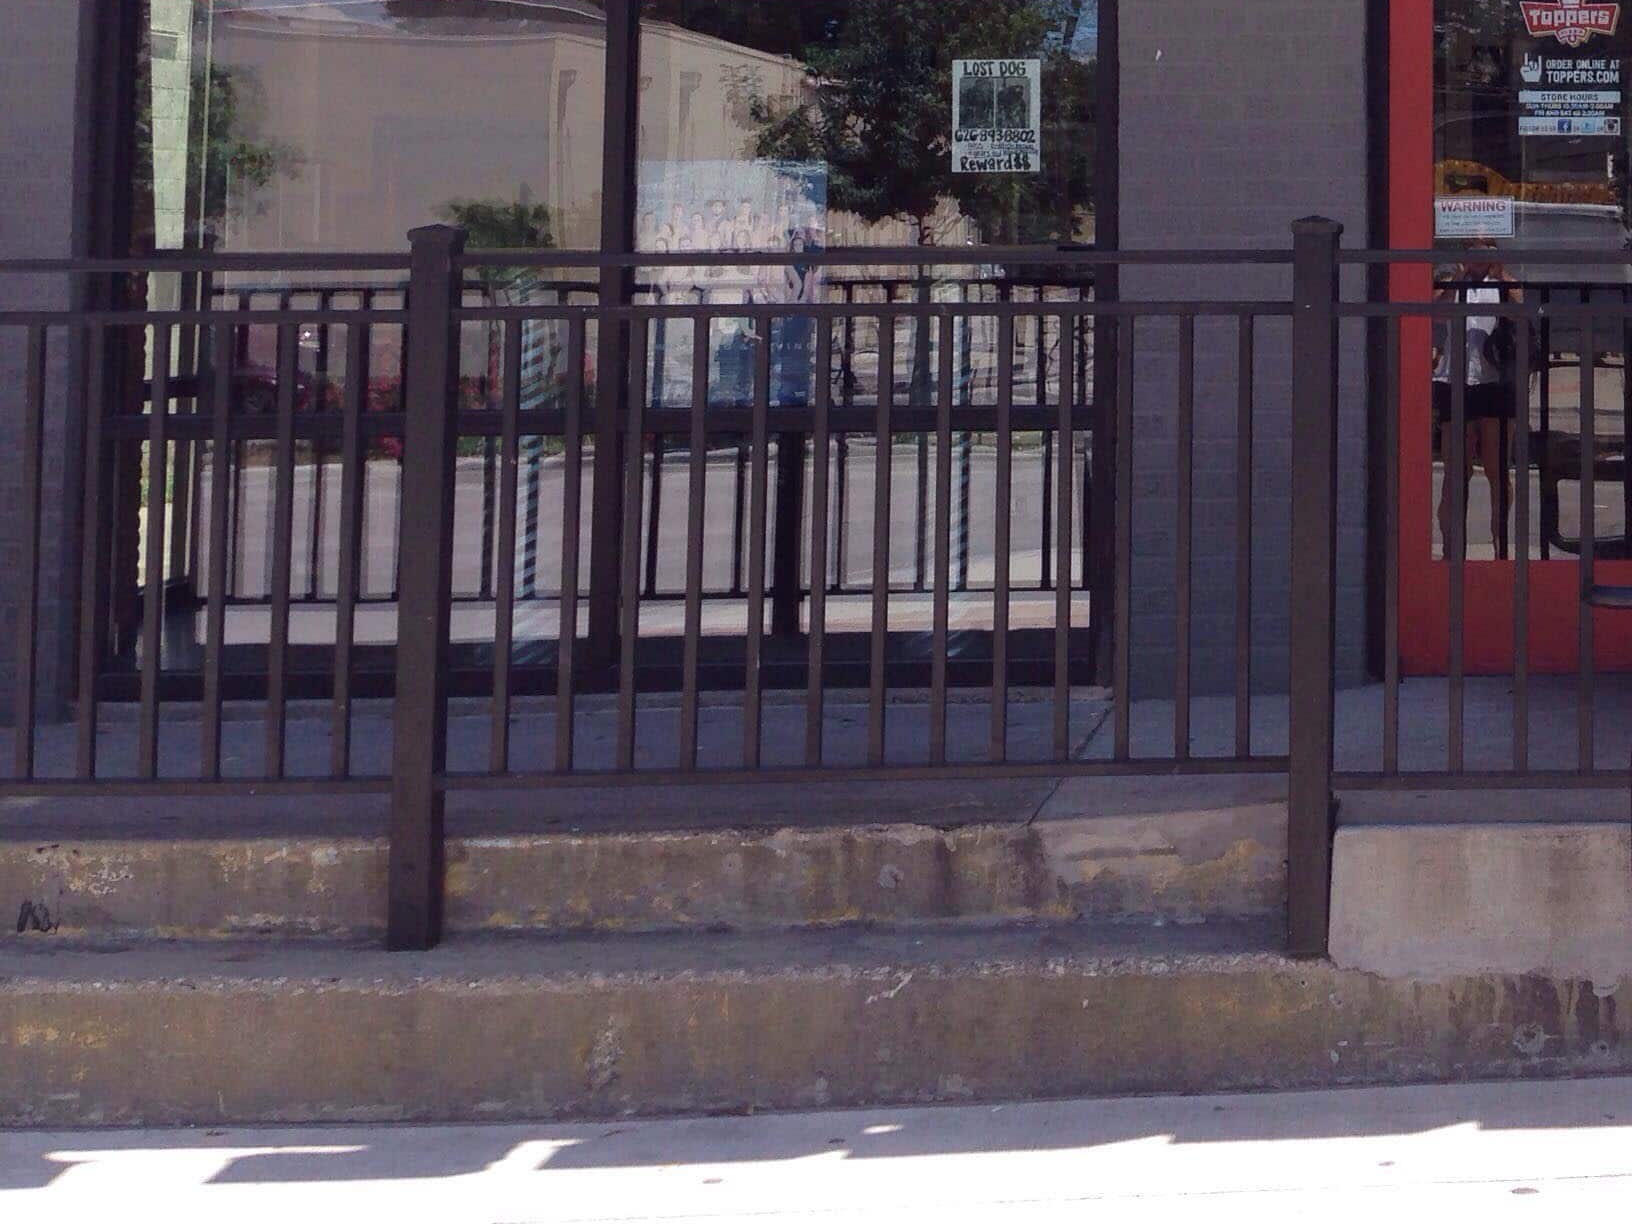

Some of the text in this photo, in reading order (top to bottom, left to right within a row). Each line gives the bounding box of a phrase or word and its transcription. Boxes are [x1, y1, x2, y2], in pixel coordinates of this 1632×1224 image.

[1529, 8, 1610, 27] Toppers
[963, 61, 1027, 76] LOST DOG
[1546, 59, 1620, 69] ORDER ONLINE AT
[1547, 70, 1620, 83] TOPPERS.COM
[1541, 93, 1599, 101] STORE HOURS
[1441, 200, 1506, 212] WARNING
